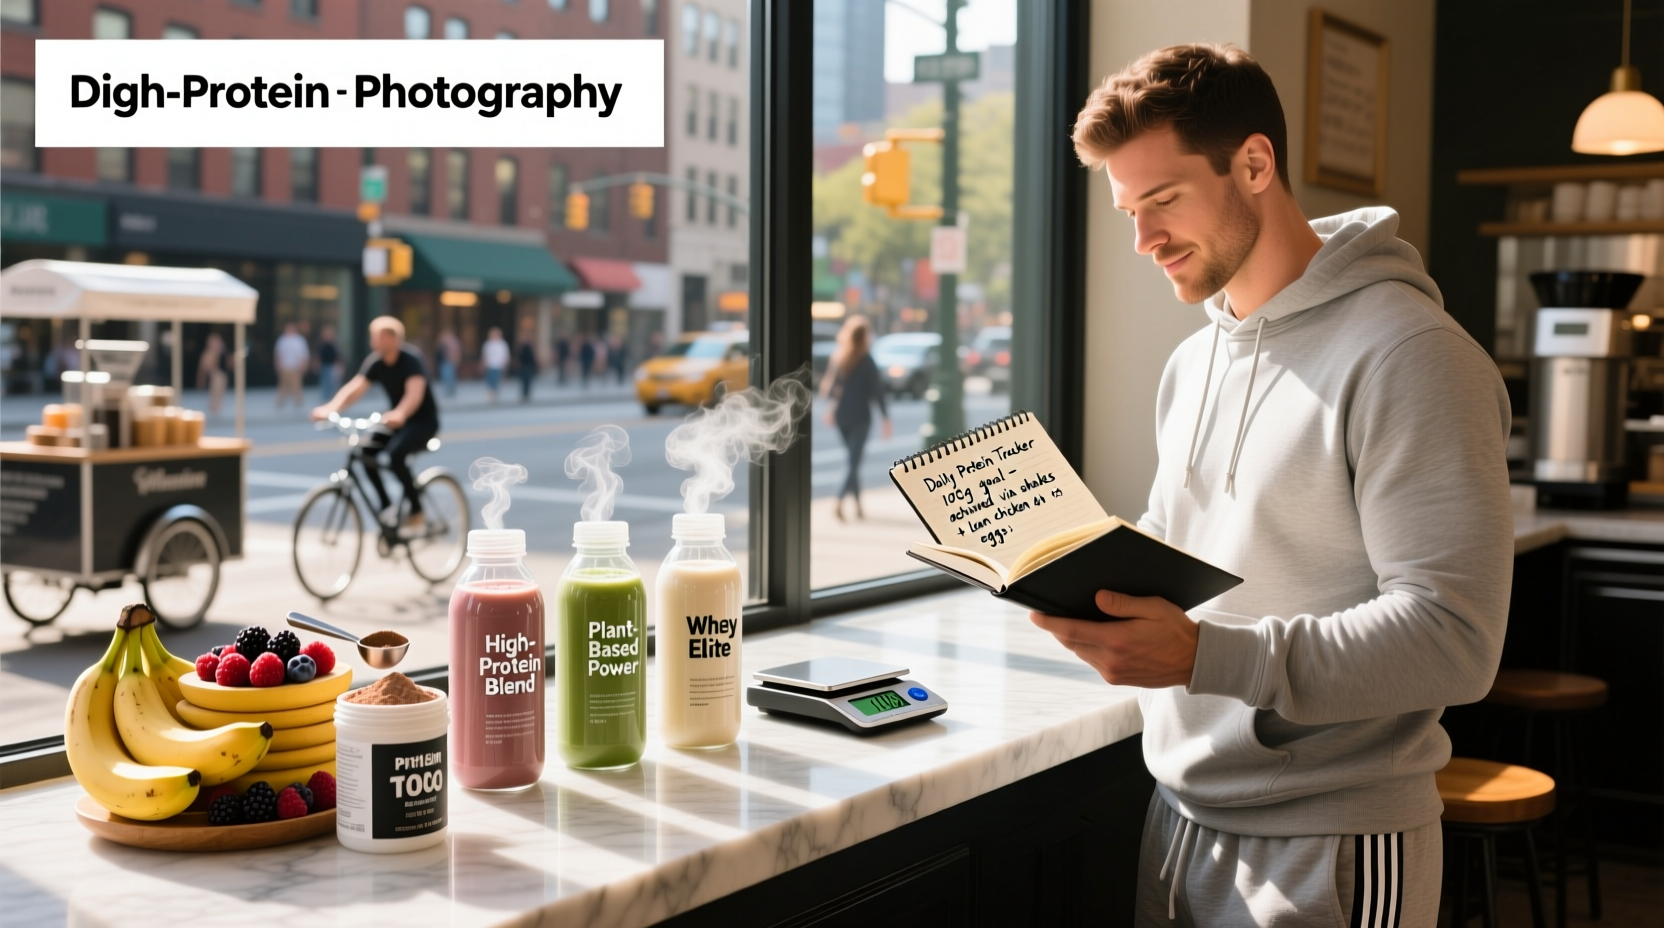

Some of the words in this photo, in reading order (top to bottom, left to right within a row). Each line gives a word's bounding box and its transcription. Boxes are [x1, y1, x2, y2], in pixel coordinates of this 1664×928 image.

[999, 488, 1017, 501] via
[588, 620, 639, 639] Plant-
[686, 614, 738, 638] Whey
[485, 632, 536, 659] High-
[588, 638, 639, 657] Based
[688, 638, 732, 659] Elite
[479, 654, 541, 676] Protein
[588, 659, 639, 677] Power
[485, 674, 536, 696] Blend
